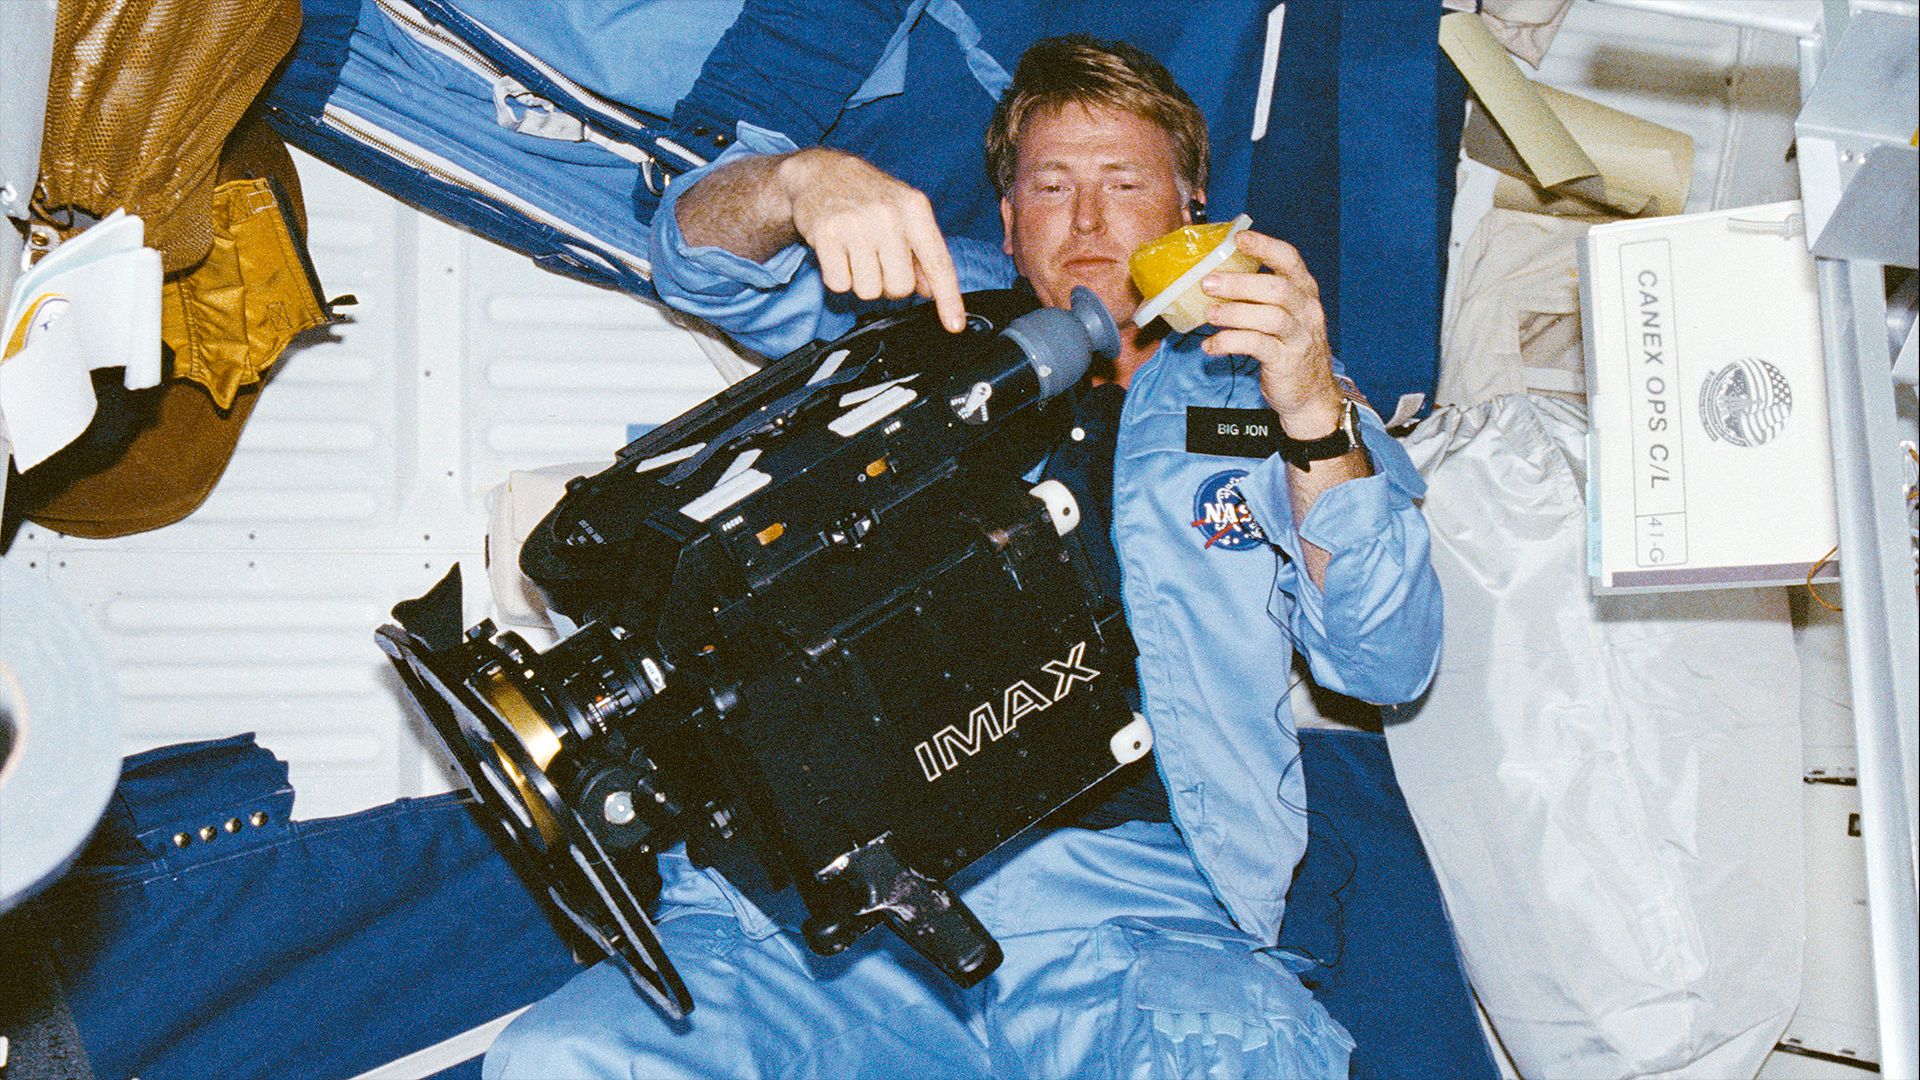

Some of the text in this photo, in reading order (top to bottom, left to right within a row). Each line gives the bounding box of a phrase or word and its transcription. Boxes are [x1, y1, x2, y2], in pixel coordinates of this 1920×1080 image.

[1638, 270, 1670, 489] CANEX OPS C/L
[1217, 423, 1269, 437] BIG JON
[1204, 502, 1253, 523] NAS
[1648, 517, 1665, 563] 41-G
[914, 641, 1101, 782] IMAX
